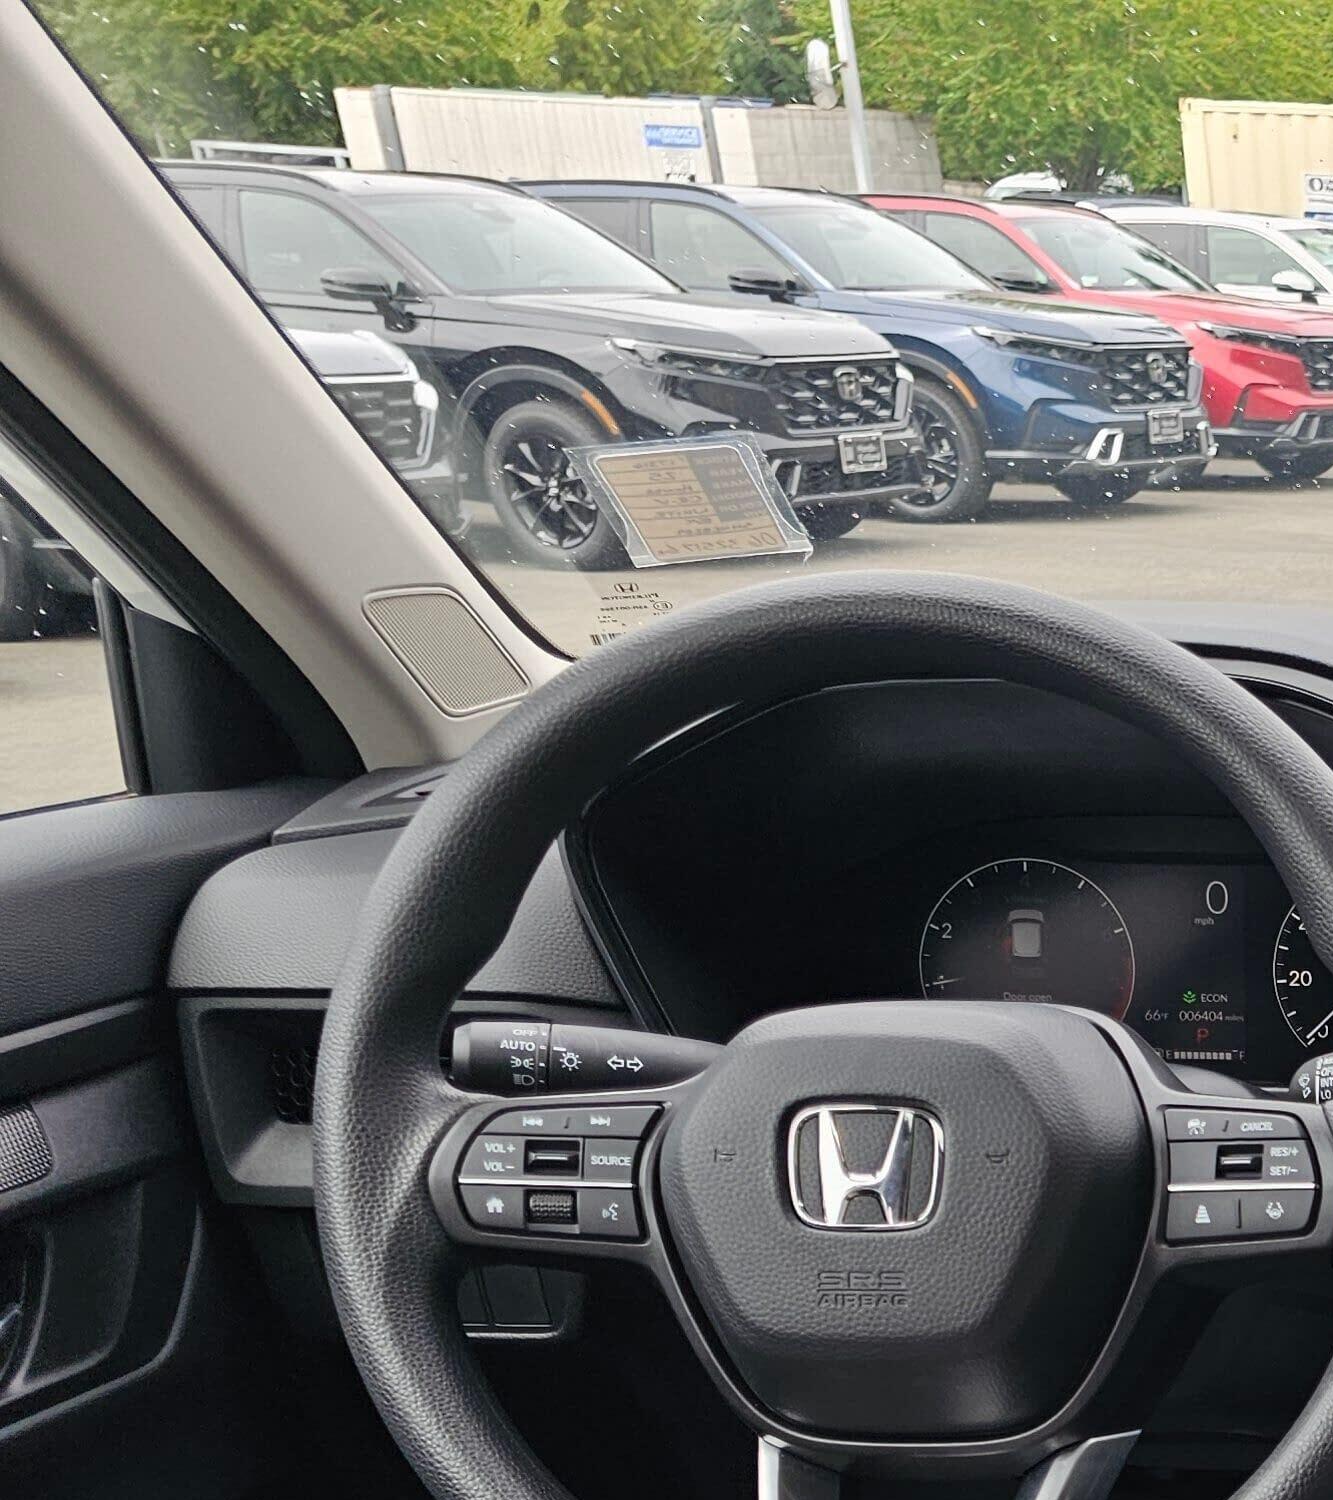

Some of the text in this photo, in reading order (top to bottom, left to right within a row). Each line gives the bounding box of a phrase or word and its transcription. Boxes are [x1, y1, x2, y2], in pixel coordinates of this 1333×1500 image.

[1205, 881, 1229, 915] 0
[1193, 916, 1215, 926] mph
[941, 922, 953, 939] 2
[1288, 970, 1313, 987] 20
[1003, 991, 1053, 1003] Door open
[1200, 993, 1229, 1003] ECON
[1178, 1010, 1224, 1022] 006404
[500, 1040, 536, 1052] AUTO
[1320, 1077, 1333, 1087] INT
[1320, 1089, 1332, 1100] LO
[590, 1155, 632, 1166] SOURCE
[817, 1270, 906, 1288] SRS
[817, 1293, 909, 1308] AIRBAG
